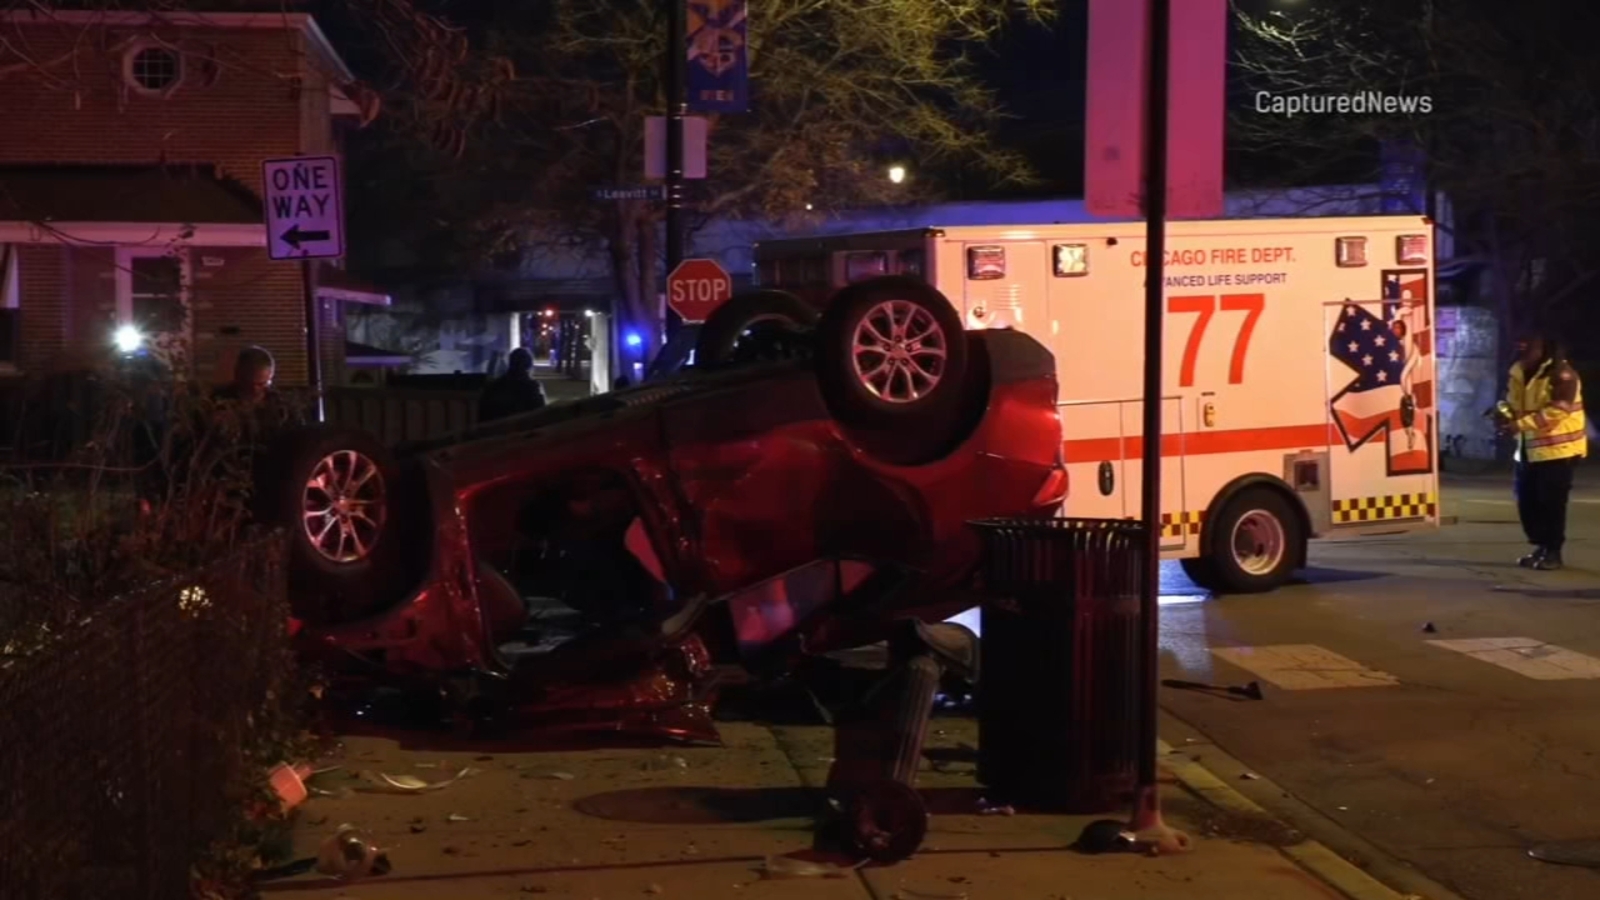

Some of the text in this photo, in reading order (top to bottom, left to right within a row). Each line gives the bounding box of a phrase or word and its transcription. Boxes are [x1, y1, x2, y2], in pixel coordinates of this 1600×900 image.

[273, 166, 328, 191] ONE
[604, 189, 647, 199] Leavitt
[273, 194, 330, 219] WAY
[1131, 247, 1296, 267] CCAGO FIRE DEPT.
[671, 279, 727, 302] STOP
[1145, 273, 1287, 288] ANCED LIFE SUPPORT
[1167, 293, 1265, 387] 77
